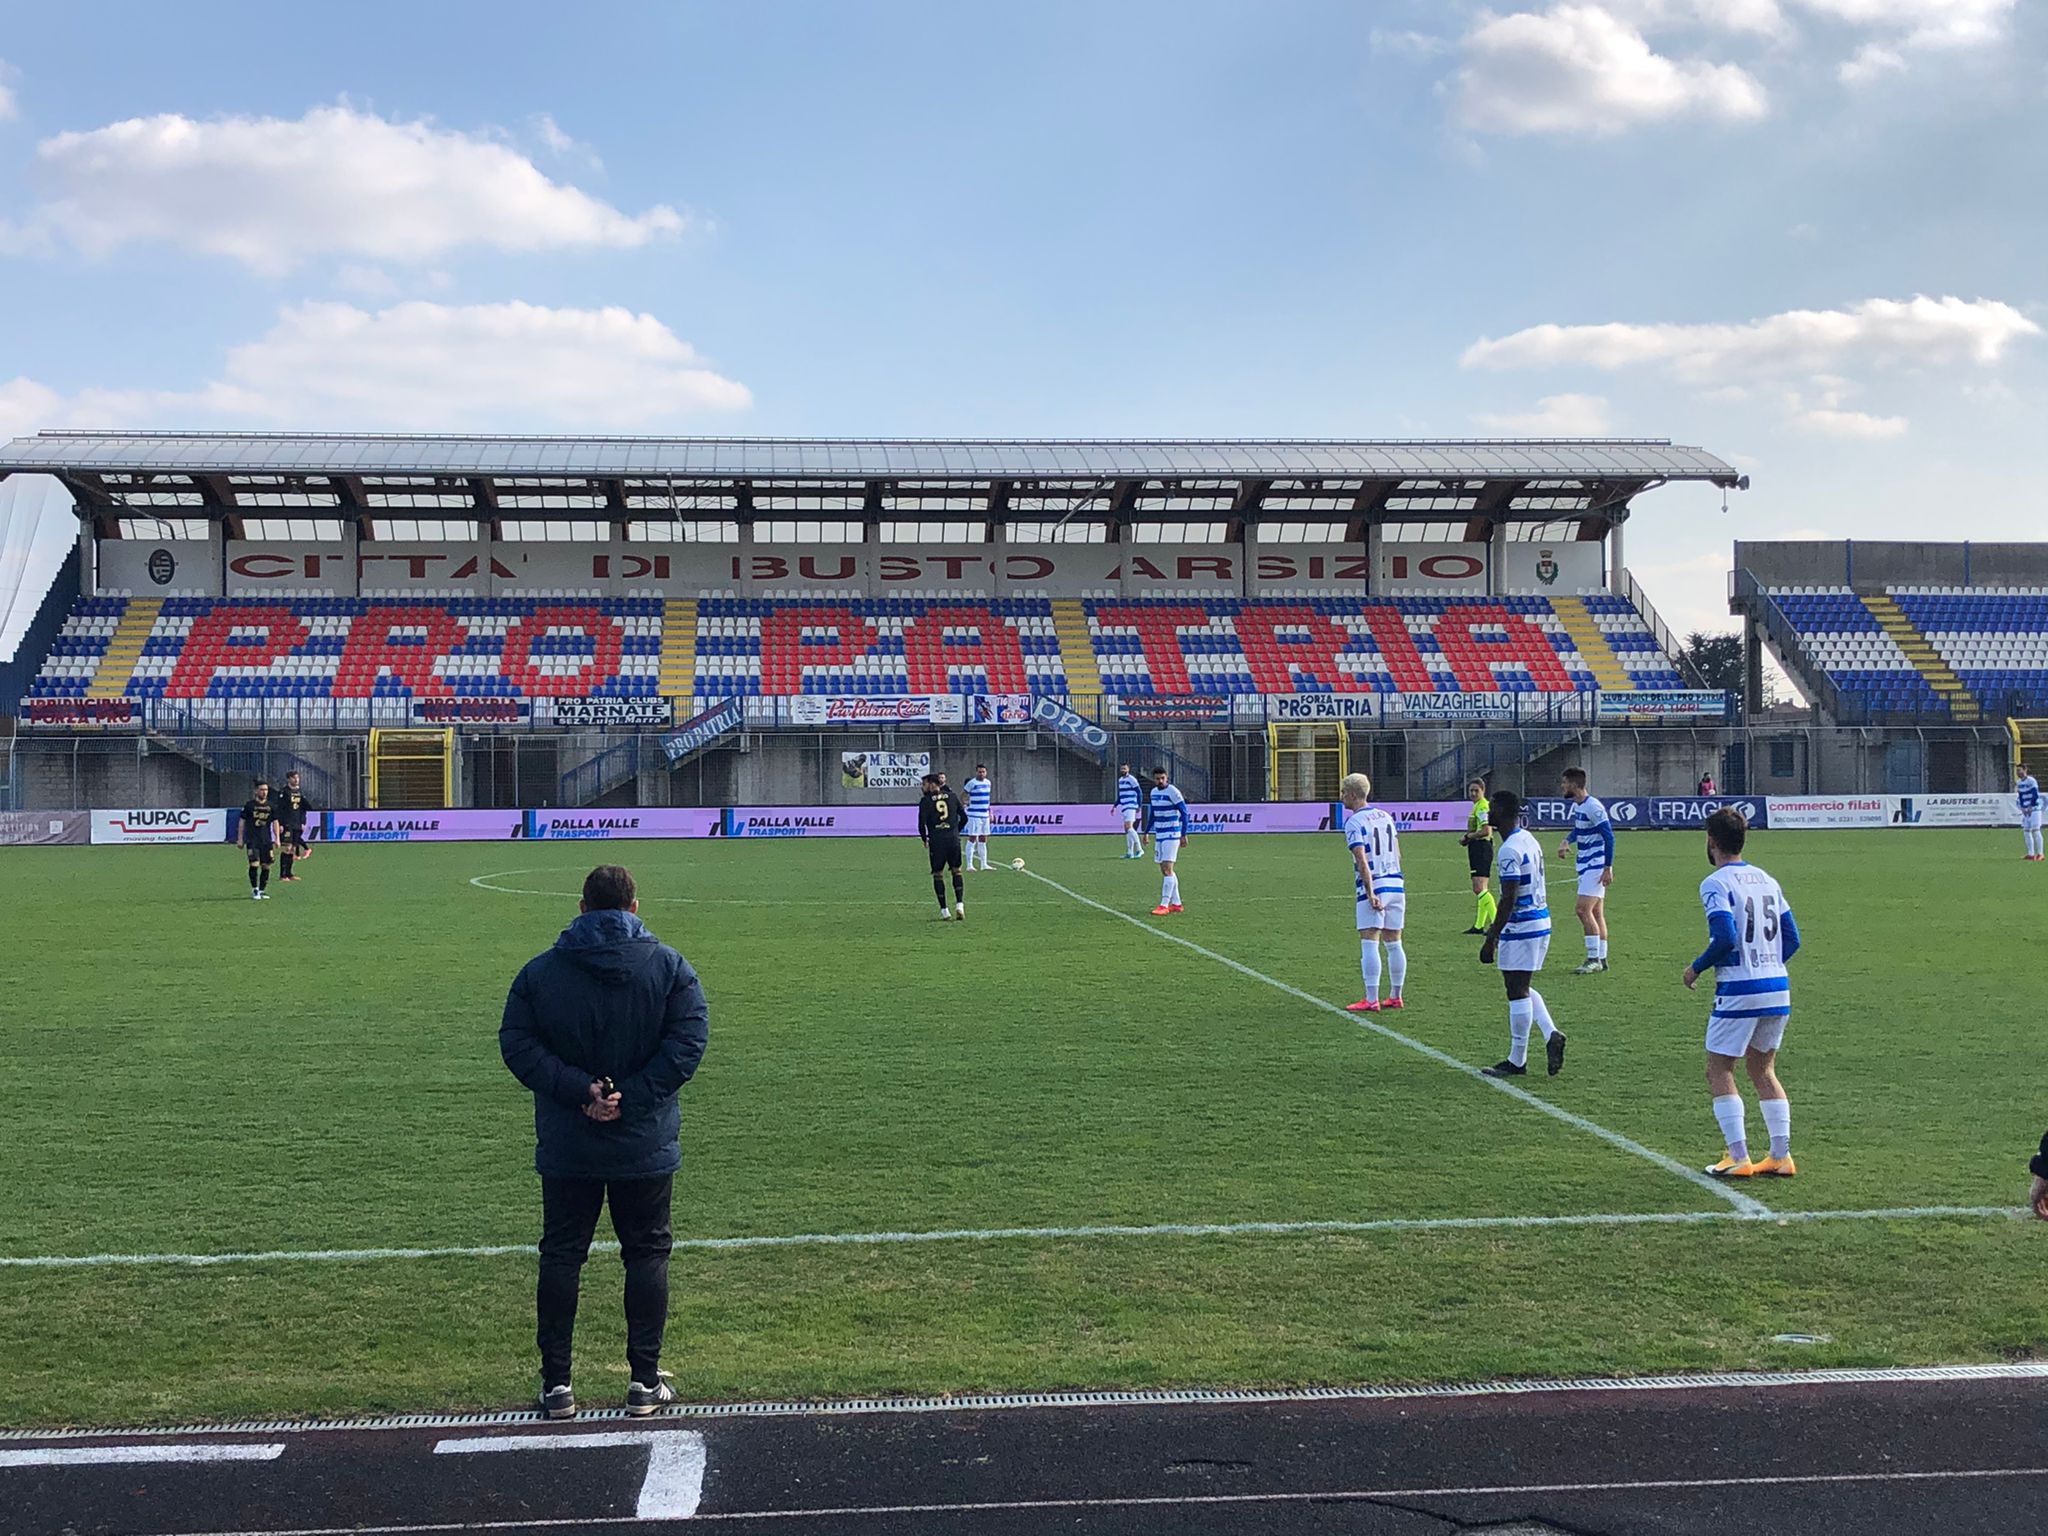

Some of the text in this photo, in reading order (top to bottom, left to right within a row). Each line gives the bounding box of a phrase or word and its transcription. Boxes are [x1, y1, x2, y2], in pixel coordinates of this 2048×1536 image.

[592, 555, 670, 579] DI
[731, 556, 1056, 580] BUSTO
[1104, 554, 1485, 580] ARSIZIO
[165, 604, 1577, 698] PRO PATRIA
[424, 698, 518, 710] PRO PATRIA
[558, 696, 665, 705] PRO PATRIA CLUBS
[1123, 696, 1225, 706] VALLE OLONA
[1300, 695, 1333, 704] FORZA
[1402, 693, 1511, 710] VANZAGHELLO
[557, 705, 665, 717] MARNATE
[850, 698, 893, 719] Patria
[896, 699, 926, 719] Club
[1278, 699, 1373, 716] PRO PATRIA
[1628, 704, 1665, 713] FORZA
[460, 709, 518, 722] CUORE
[666, 706, 742, 760] PRO PATRIA
[880, 767, 919, 776] SEMPRE
[869, 777, 890, 786] CON
[893, 777, 911, 786] NOI
[935, 800, 949, 820] 9
[1769, 800, 1880, 811] commercio filati
[128, 811, 191, 825] HUPAC
[990, 815, 1064, 824] ALLA VALLE
[1213, 814, 1252, 823] VALLE
[1401, 812, 1440, 821] VALLE
[350, 821, 440, 831] DALLA VALLE
[552, 819, 640, 829] DALLA VALLE
[749, 817, 834, 827] DALLA VALLE
[350, 832, 410, 840] TRASPORTI
[551, 830, 610, 838] TRASPORTI
[749, 828, 806, 836] TRASPORTI
[1373, 823, 1393, 856] 11
[1744, 895, 1779, 943] 15
